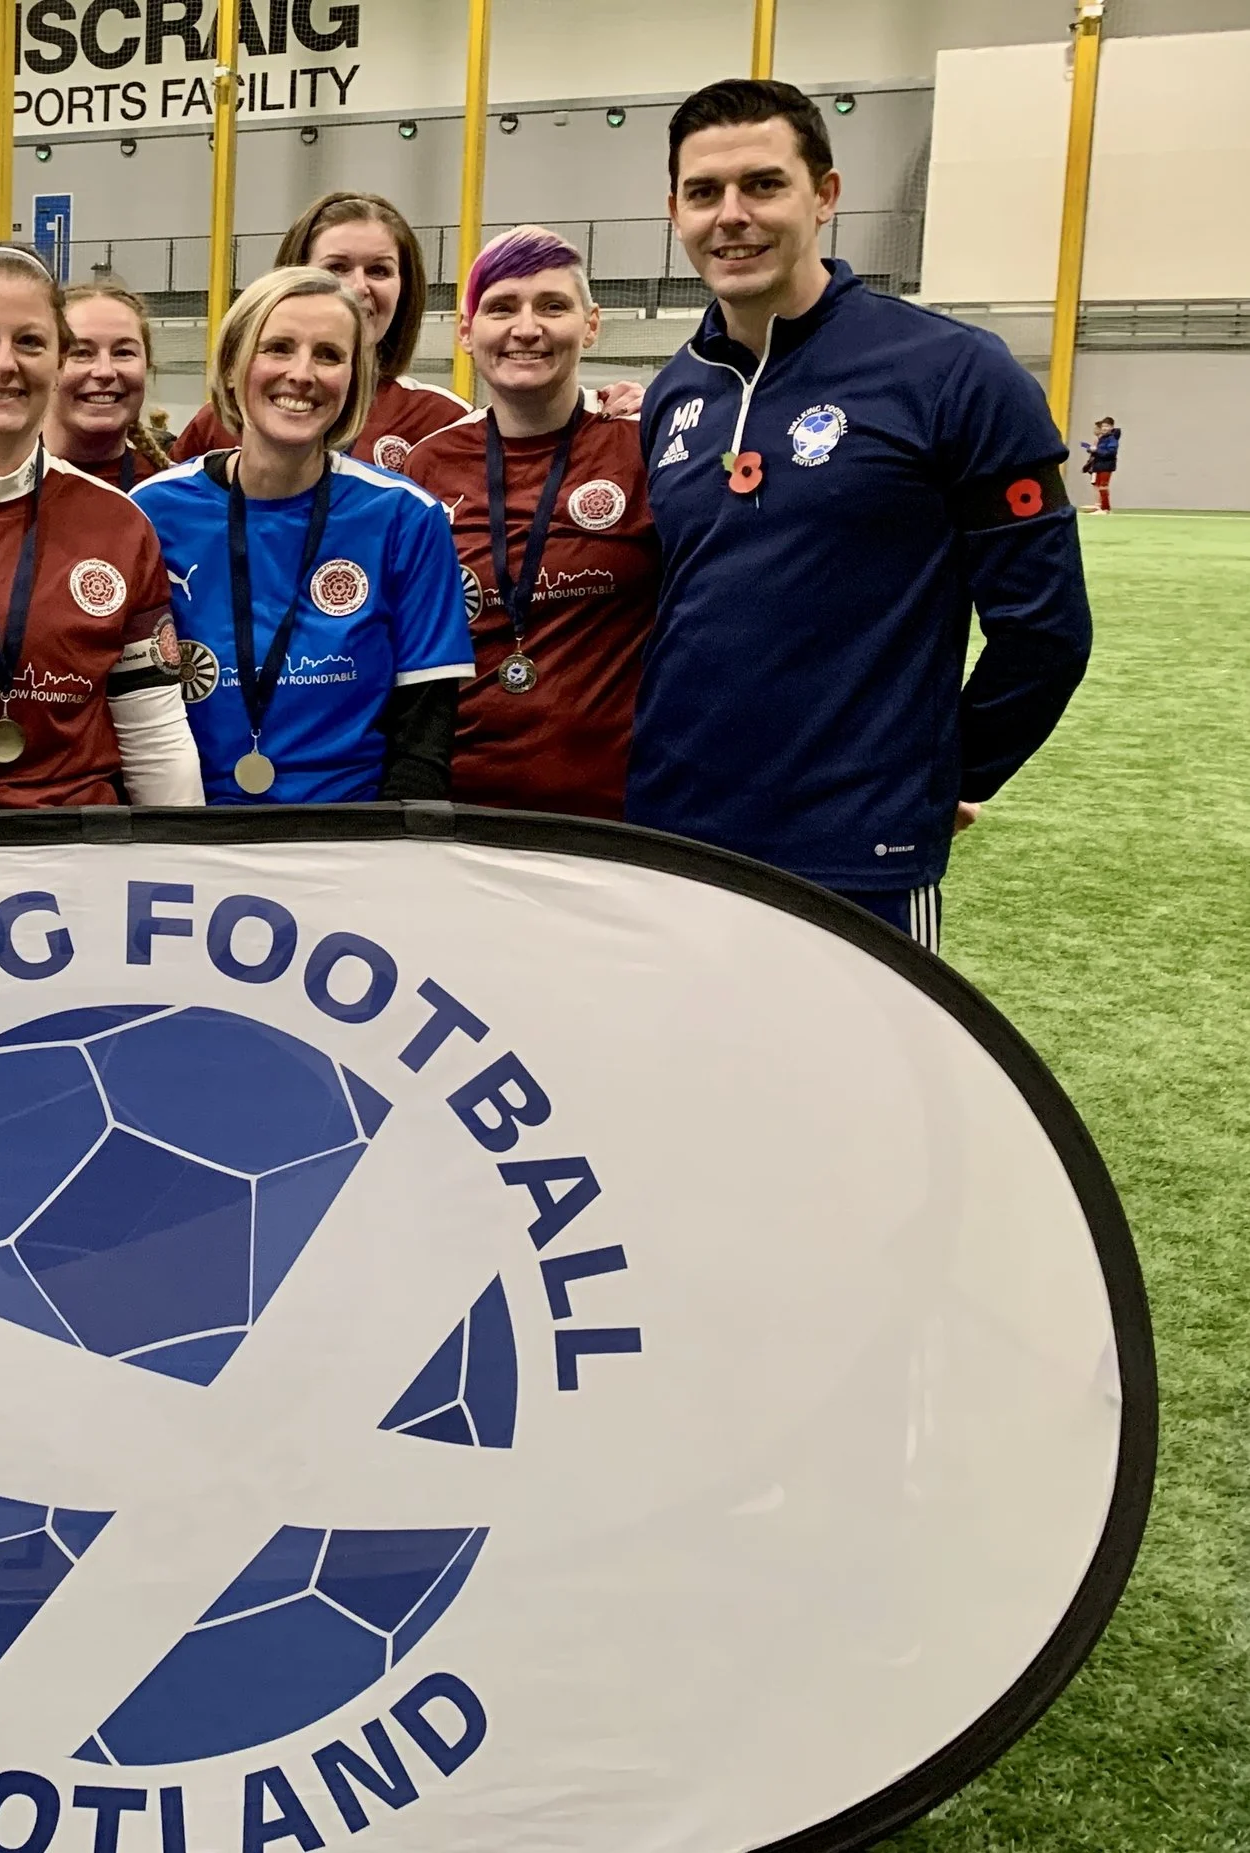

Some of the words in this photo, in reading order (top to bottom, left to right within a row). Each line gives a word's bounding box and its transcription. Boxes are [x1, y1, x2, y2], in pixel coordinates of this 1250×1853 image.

[668, 397, 704, 436] MR
[787, 405, 821, 435] WALKING
[791, 453, 830, 467] SCOTLAND
[547, 584, 616, 600] ROUNDTABLE
[290, 670, 357, 685] ROUNDTABLE
[31, 690, 90, 704] ROUNDTAB
[126, 880, 642, 1391] FOOTBALL
